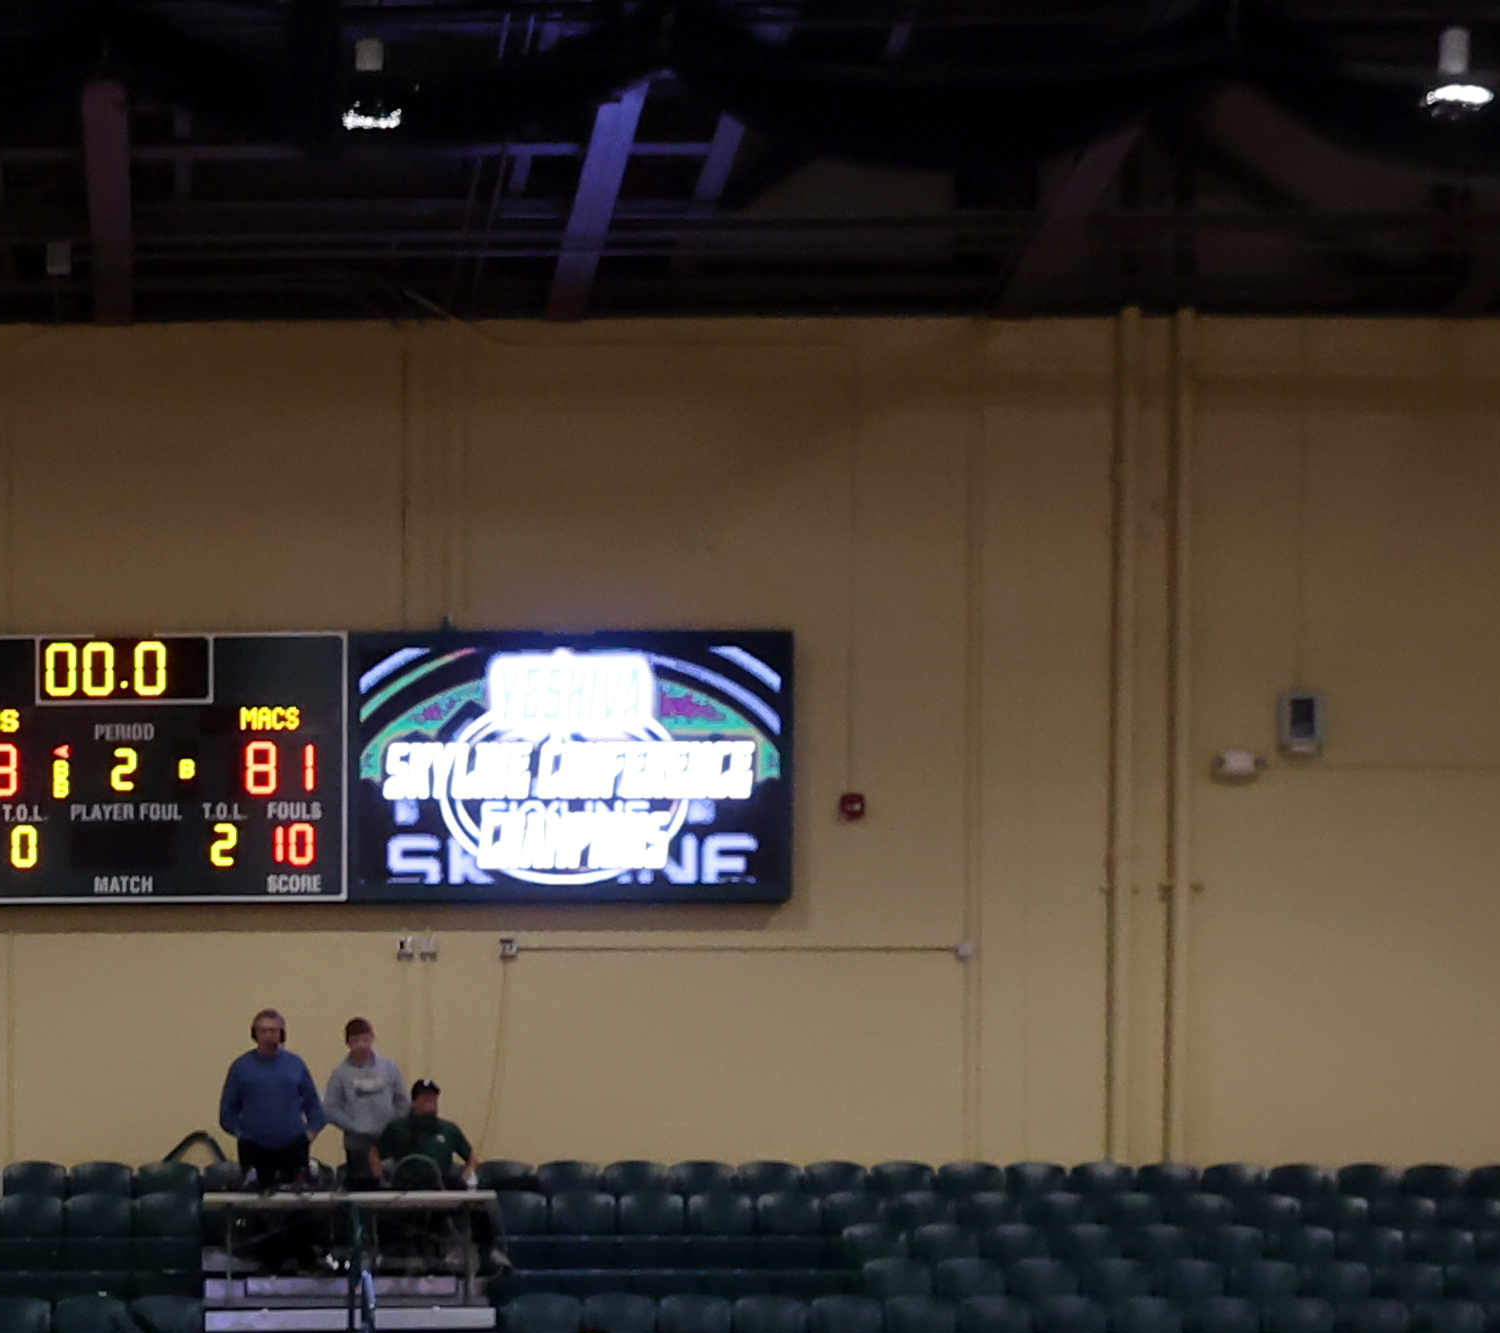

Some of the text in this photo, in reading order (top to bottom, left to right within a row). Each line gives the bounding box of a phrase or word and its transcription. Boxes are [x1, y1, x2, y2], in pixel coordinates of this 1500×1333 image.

[45, 641, 167, 697] 00.0
[94, 722, 155, 741] PERIOD
[239, 706, 300, 731] MACS
[111, 747, 139, 791] 2
[246, 741, 315, 794] 81
[70, 803, 183, 822] PLAYER FOUL
[267, 801, 322, 820] FOULS
[10, 824, 39, 869] 0
[210, 822, 239, 867] 2
[273, 822, 315, 866] 10
[93, 876, 154, 893] MATCH
[266, 874, 322, 894] SCORE
